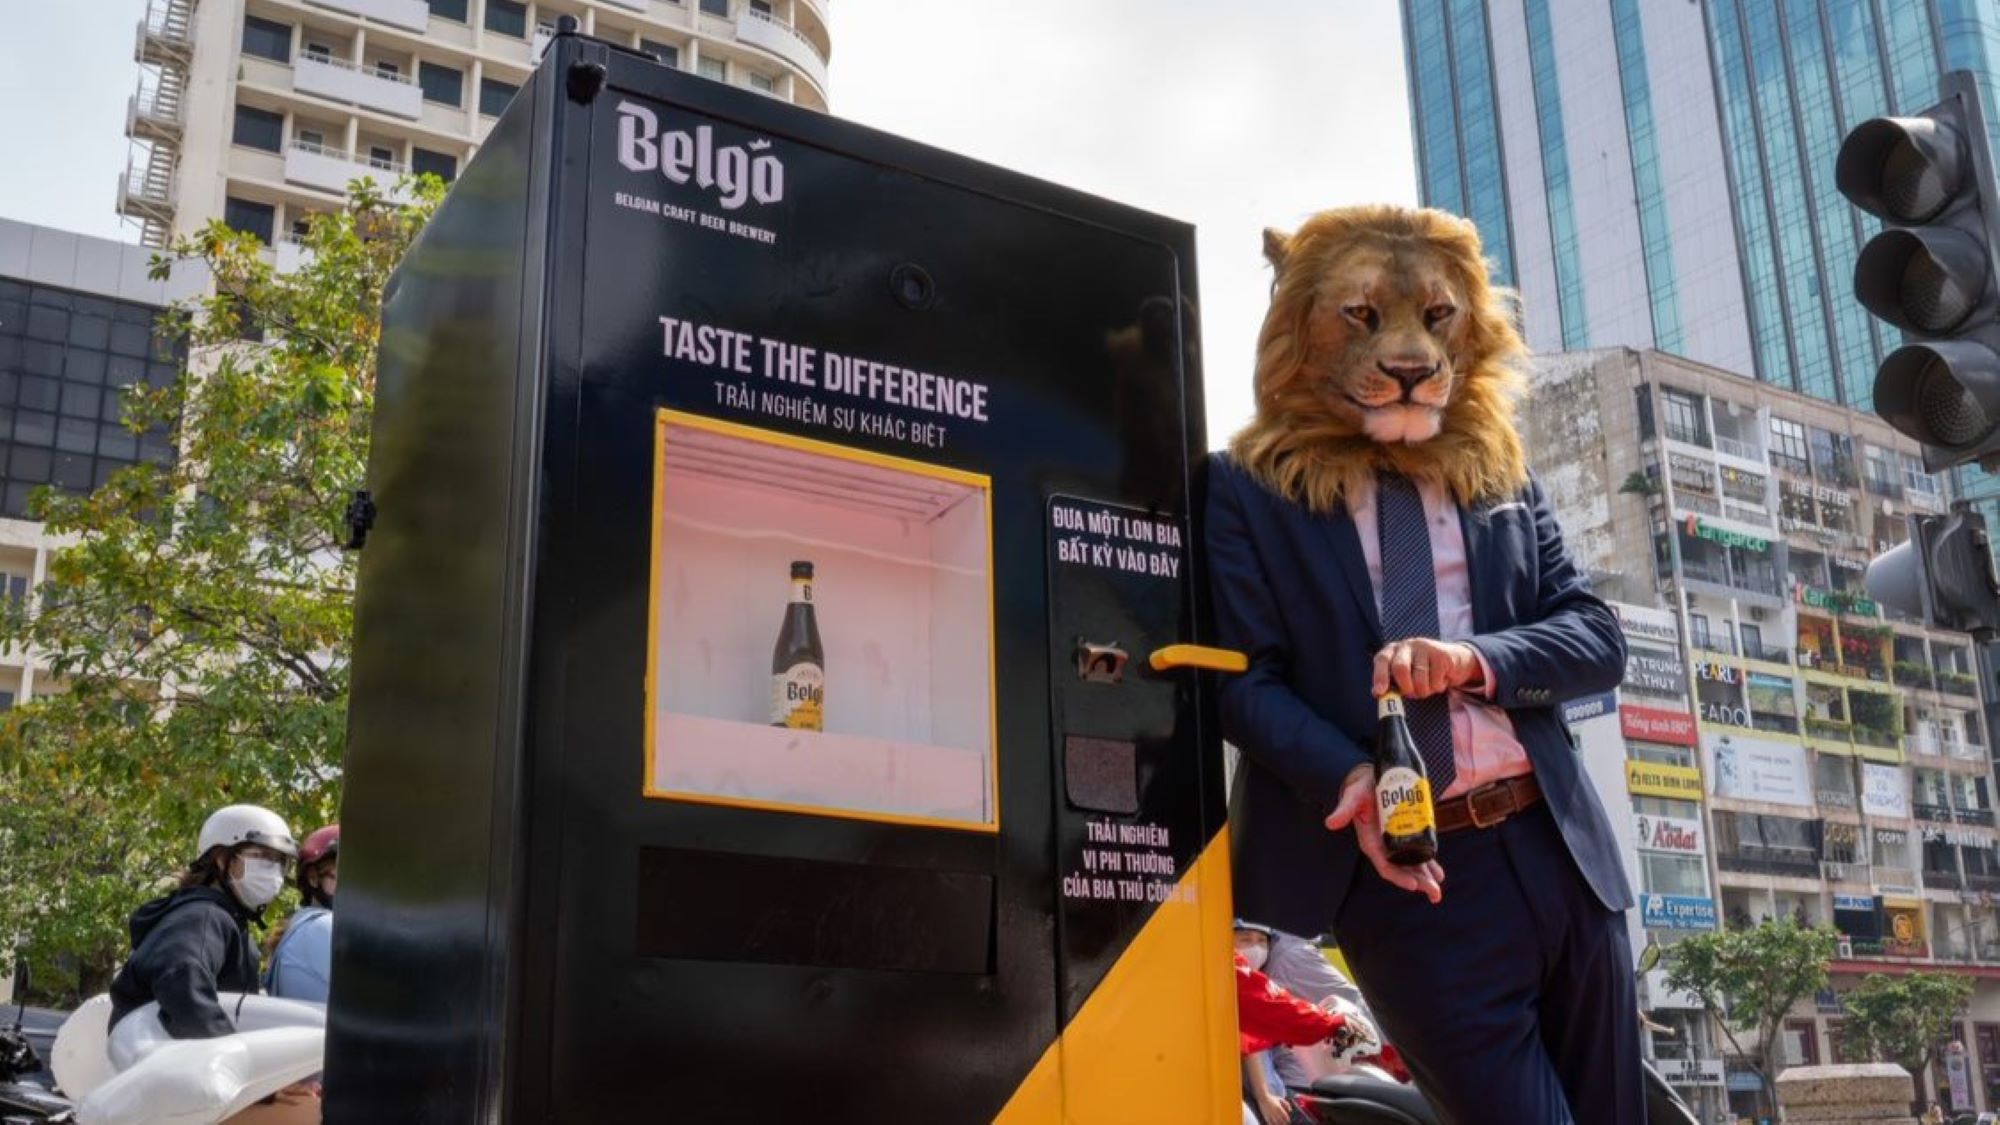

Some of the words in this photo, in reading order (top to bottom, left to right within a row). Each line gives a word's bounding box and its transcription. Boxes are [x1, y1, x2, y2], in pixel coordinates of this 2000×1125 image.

[615, 191, 660, 215] BELGIAN
[663, 203, 696, 224] CRAFT
[700, 213, 726, 232] BEER
[729, 220, 776, 244] BREWERY
[659, 316, 752, 373] TASTE
[760, 338, 816, 386] THE
[824, 352, 988, 421] DIFFERENCE
[860, 410, 906, 440] KHÁC
[1088, 509, 1120, 539] MỘT
[1124, 517, 1152, 542] LON
[1157, 523, 1181, 547] BIA
[1116, 545, 1147, 573] VÀO
[1150, 552, 1179, 578] ĐÂY
[1100, 852, 1122, 872] PHI
[1093, 879, 1116, 899] BIA
